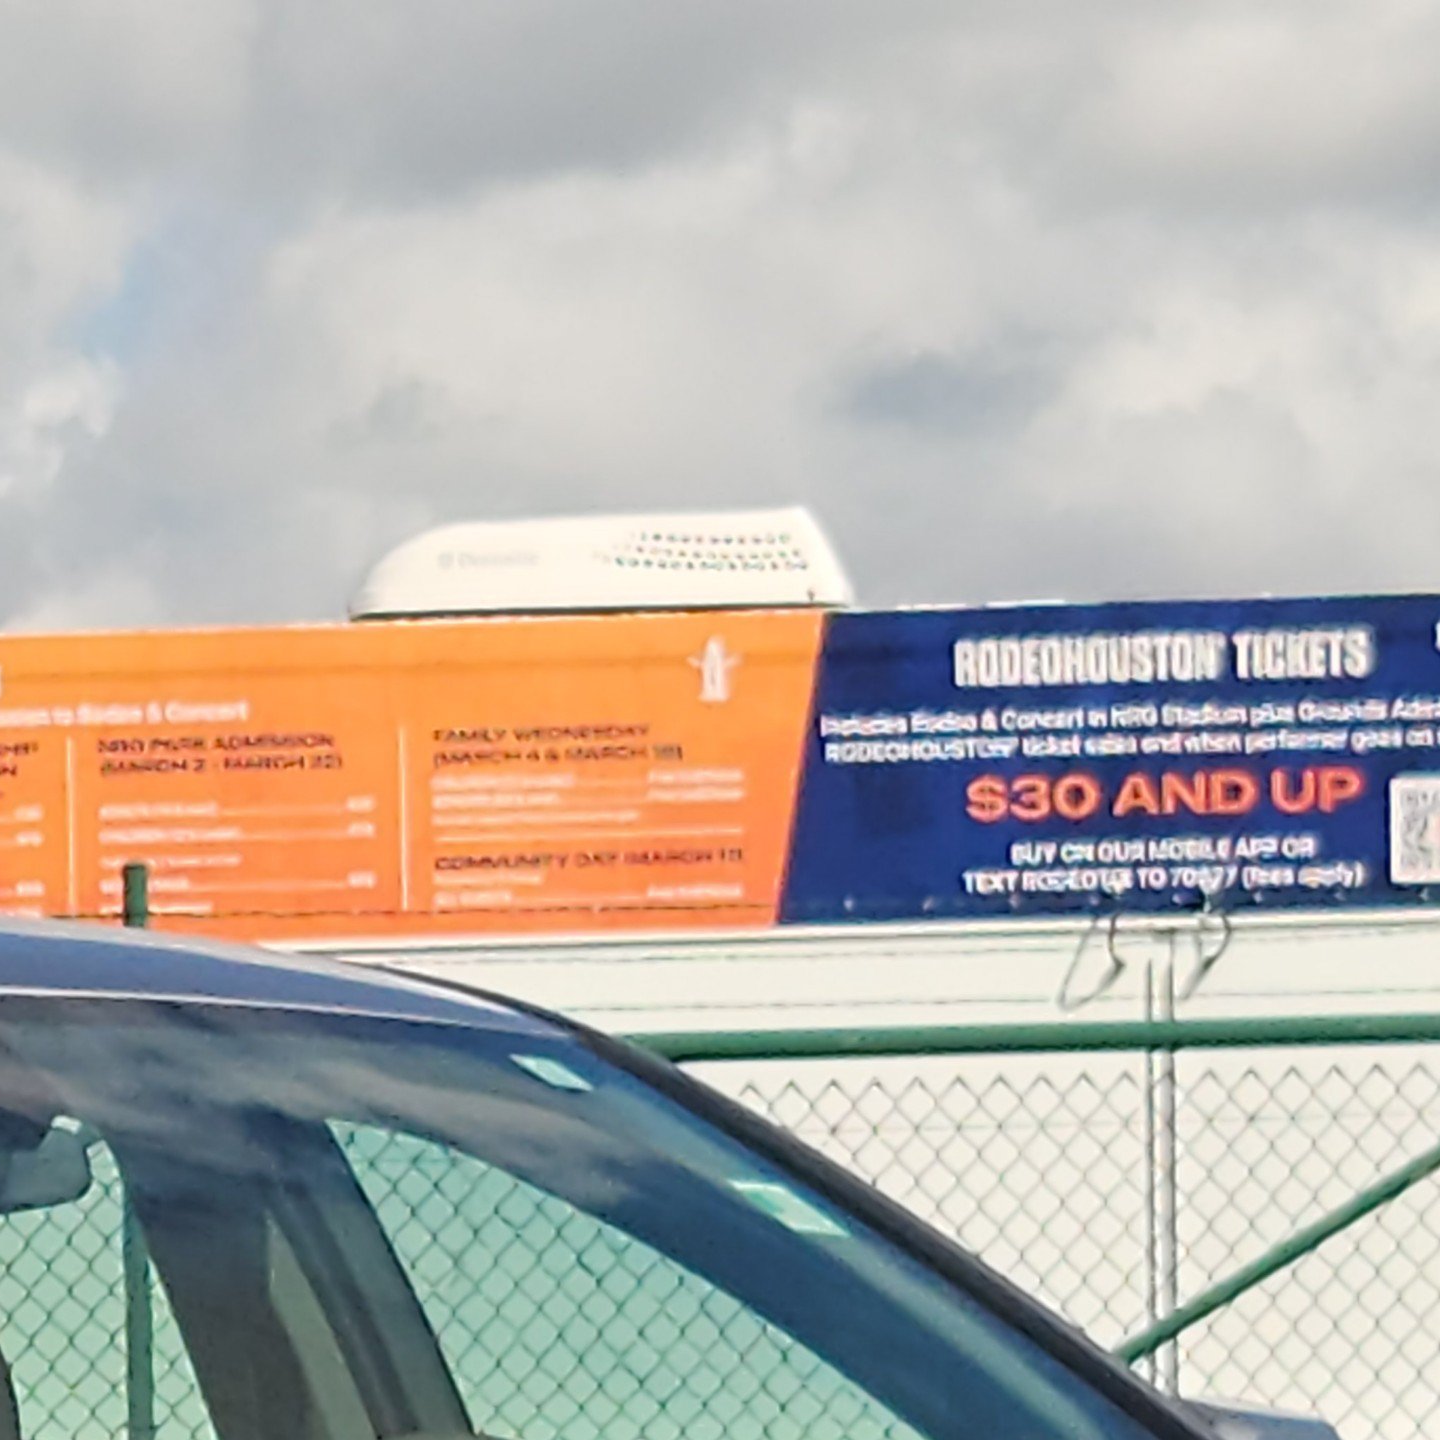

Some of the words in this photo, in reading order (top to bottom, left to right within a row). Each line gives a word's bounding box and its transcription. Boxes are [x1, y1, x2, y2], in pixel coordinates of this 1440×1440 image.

[1232, 629, 1372, 679] TICKETS
[1001, 706, 1085, 731] Concert
[966, 773, 1102, 823] $30
[1111, 768, 1261, 818] AND
[1272, 766, 1365, 815] UP
